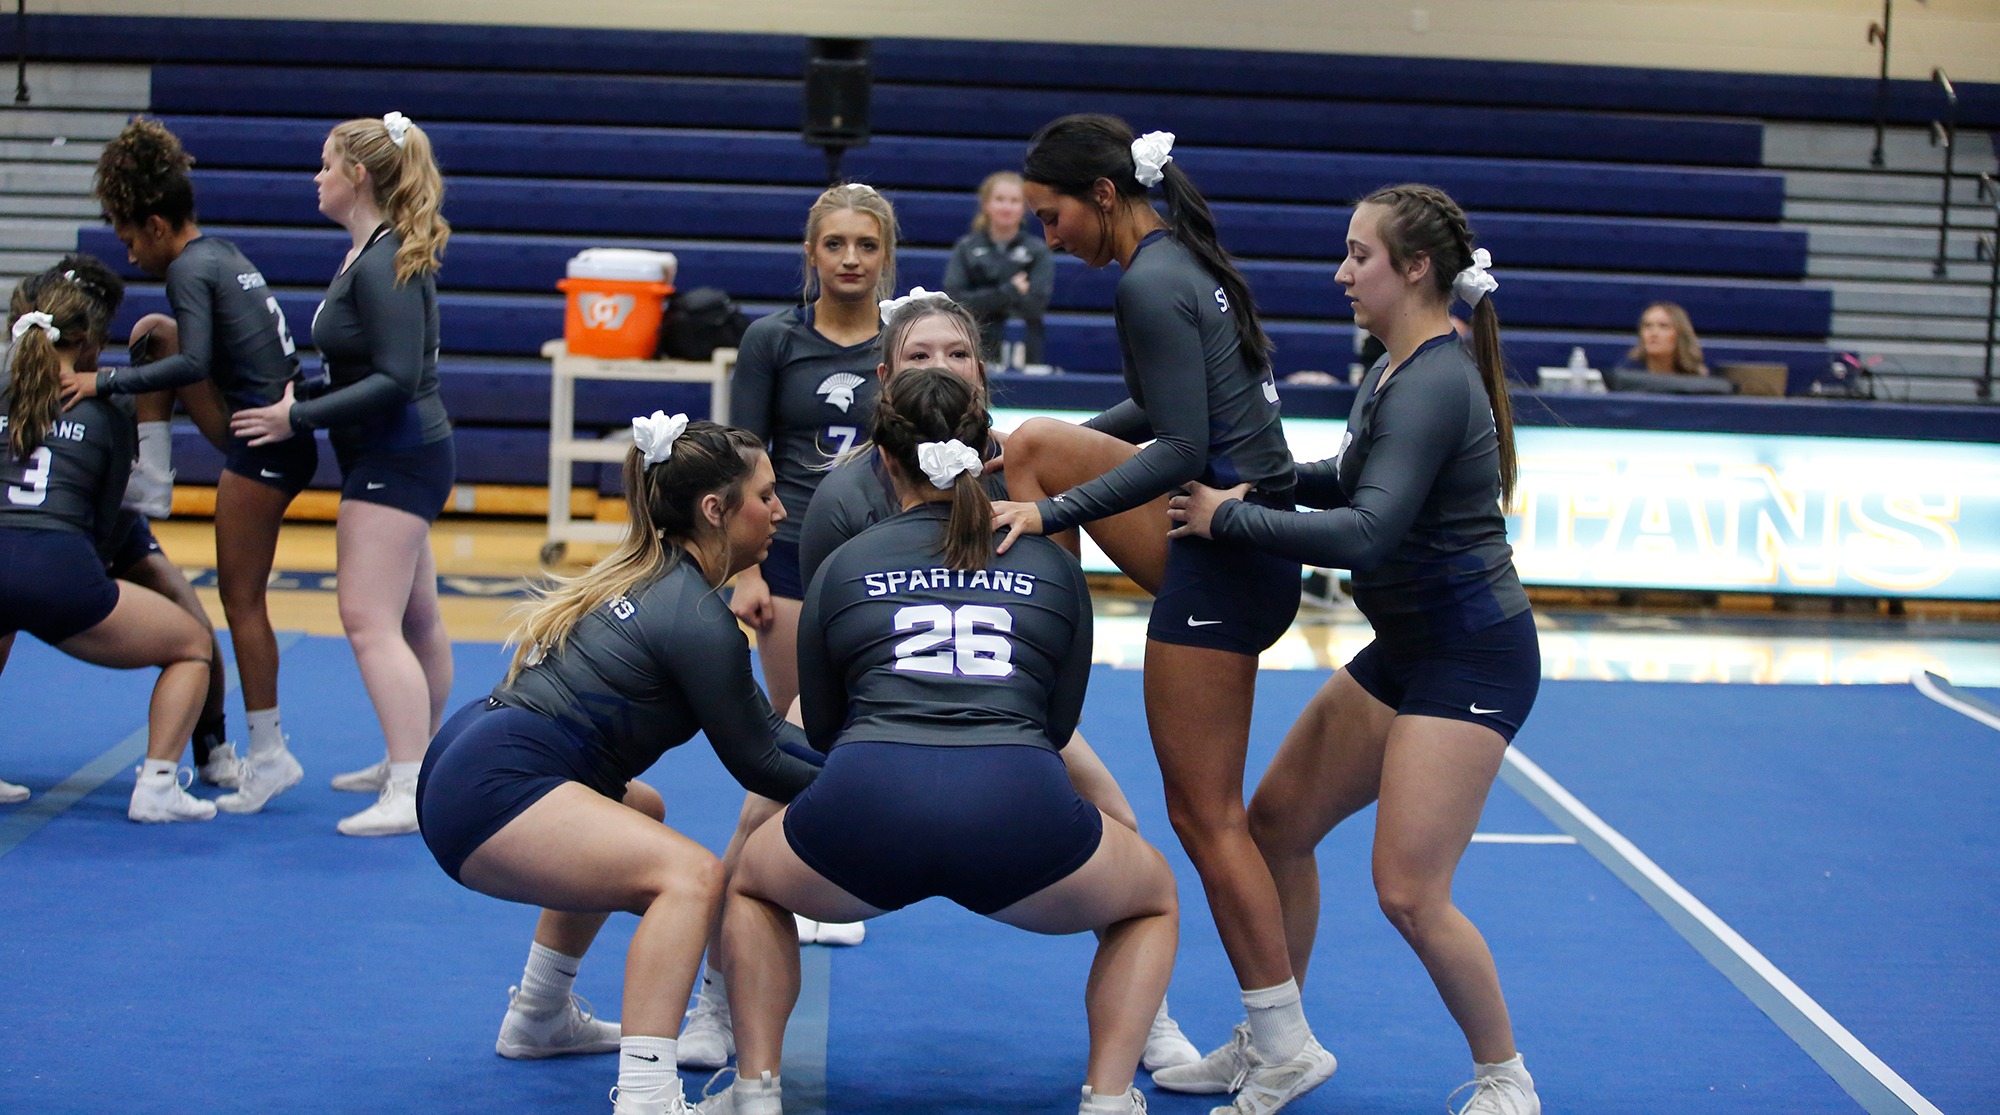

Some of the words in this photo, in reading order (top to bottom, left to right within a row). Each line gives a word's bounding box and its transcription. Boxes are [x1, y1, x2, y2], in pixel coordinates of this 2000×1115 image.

[828, 425, 857, 468] 7
[8, 446, 52, 506] 3
[865, 568, 1035, 597] SPARTANS
[894, 604, 1013, 677] 26
